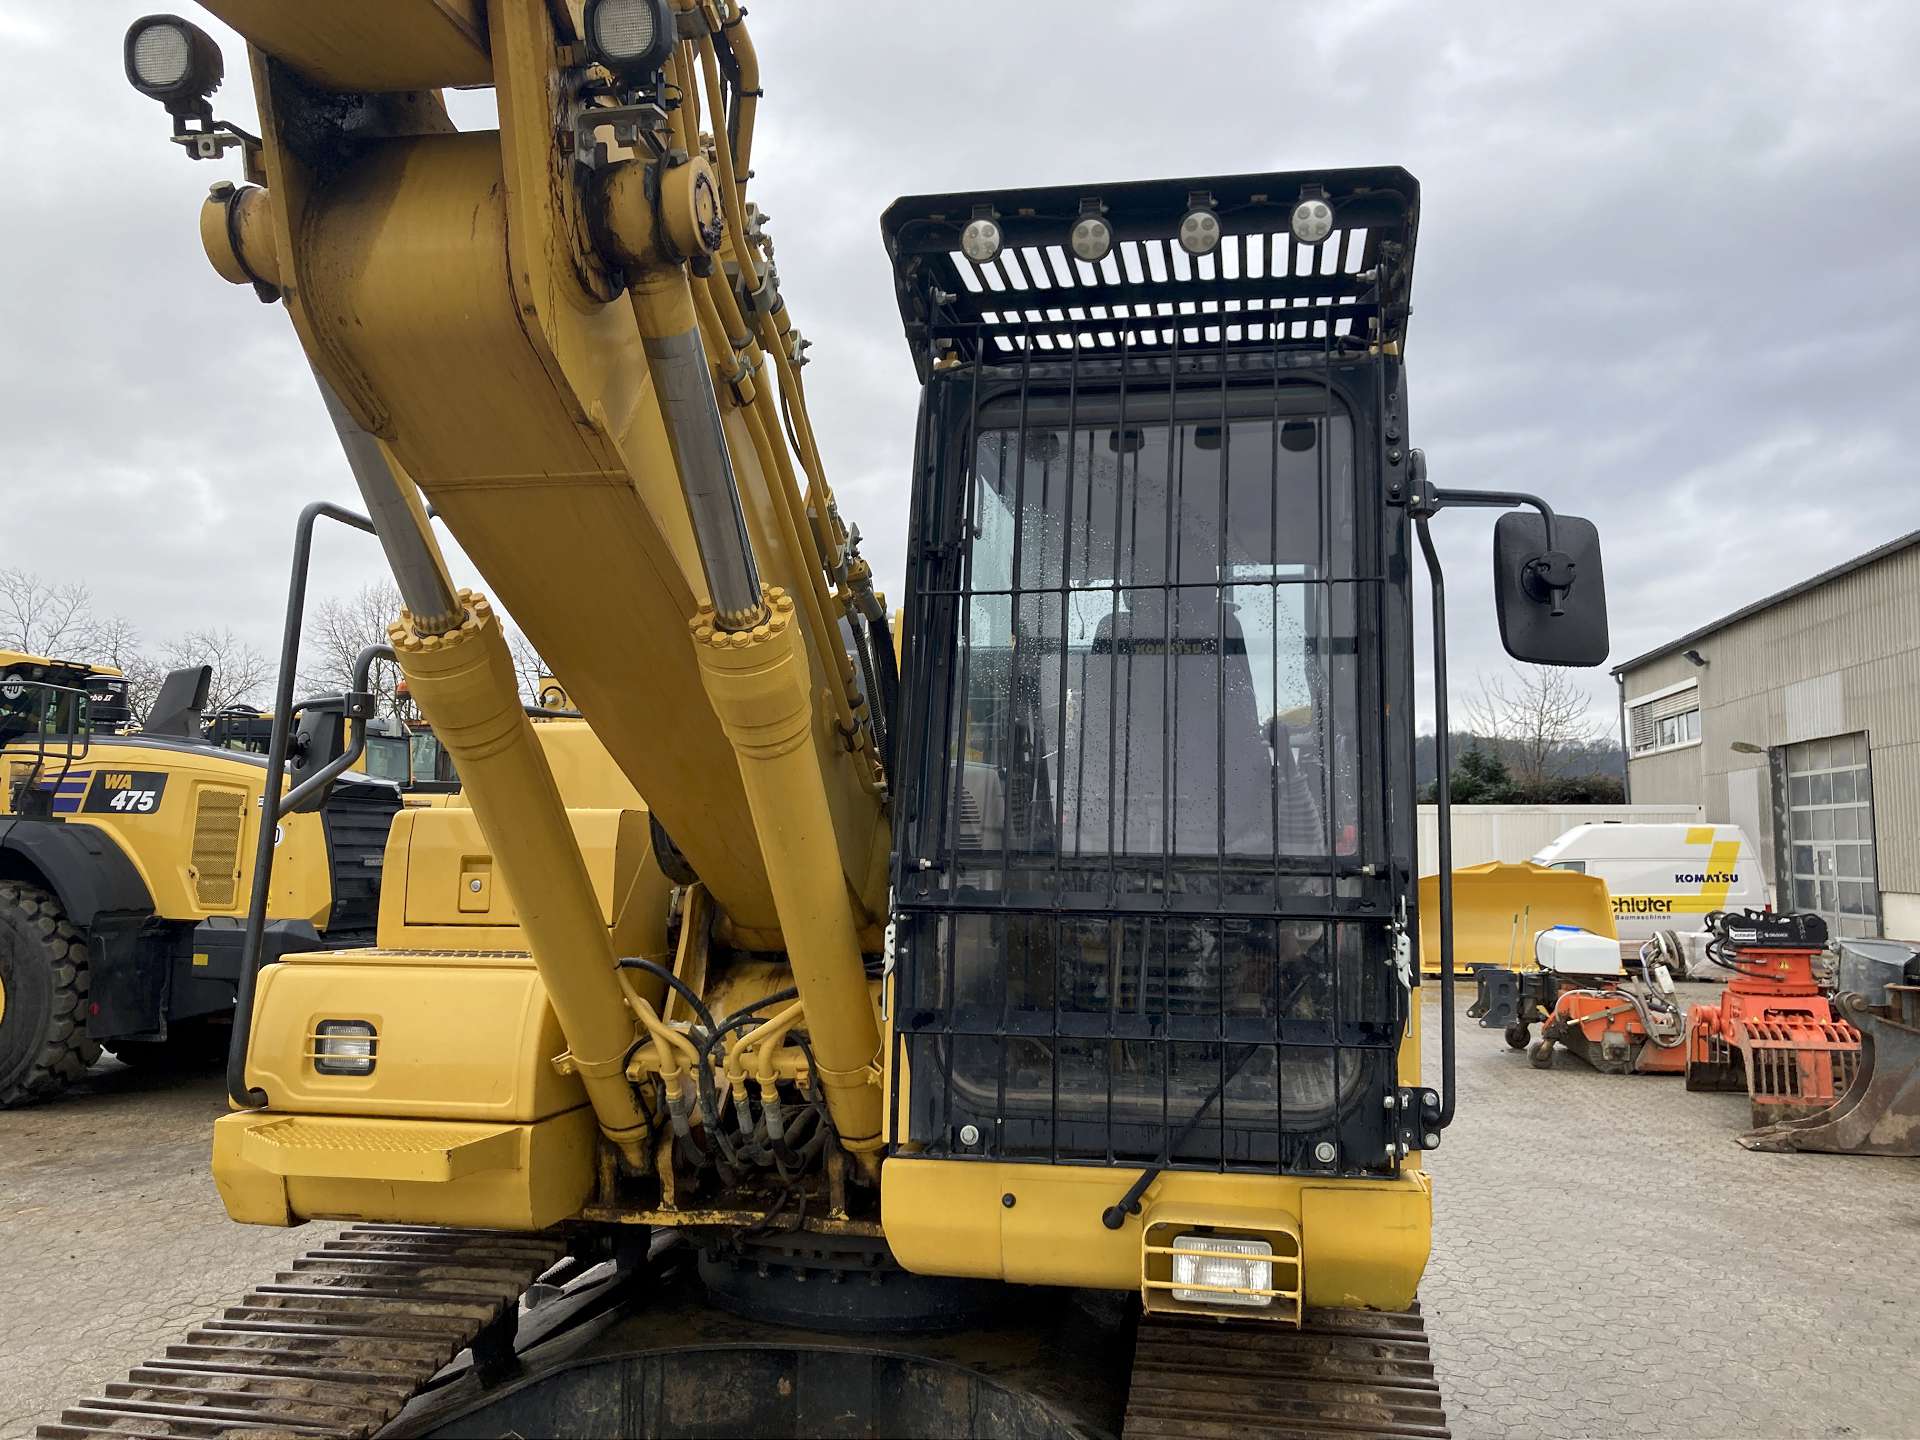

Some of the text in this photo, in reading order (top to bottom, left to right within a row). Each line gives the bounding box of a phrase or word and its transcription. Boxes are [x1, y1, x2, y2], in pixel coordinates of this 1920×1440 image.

[105, 774, 132, 790] WA
[110, 790, 156, 811] 475
[1675, 871, 1739, 883] KOMATSU
[1611, 897, 1672, 913] chlüter
